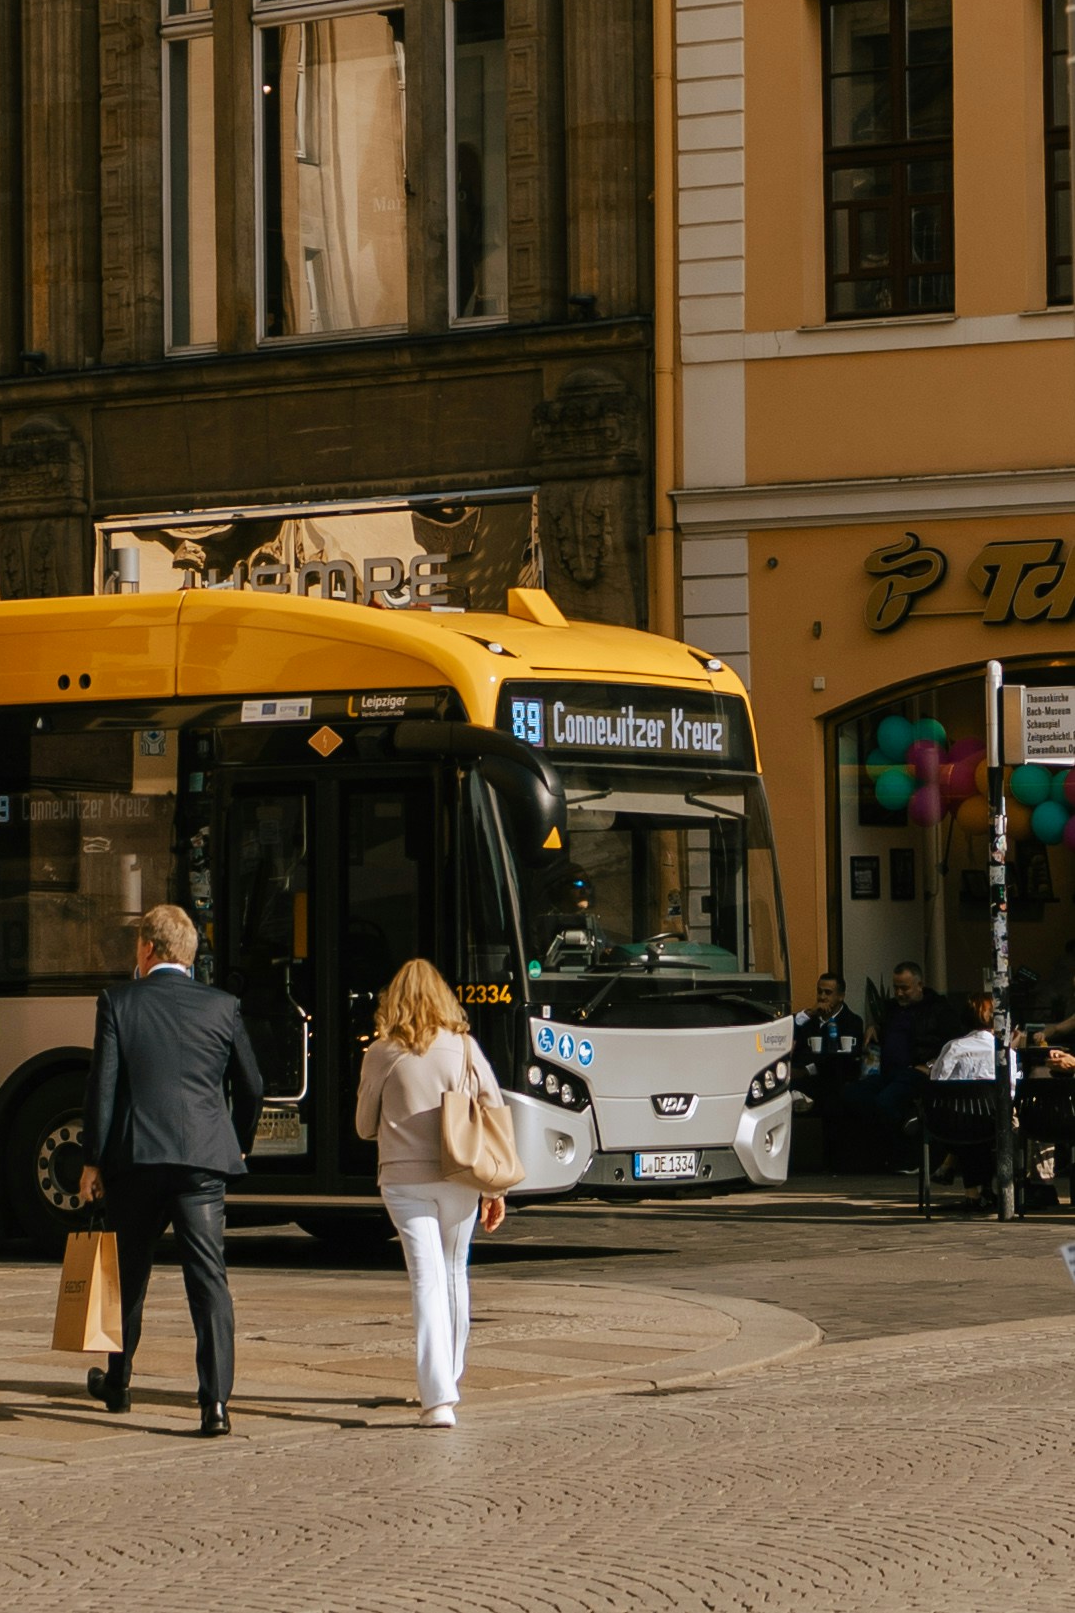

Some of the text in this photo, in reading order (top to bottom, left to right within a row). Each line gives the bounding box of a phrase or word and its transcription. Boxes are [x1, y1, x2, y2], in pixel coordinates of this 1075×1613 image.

[361, 694, 407, 709] Leipziger
[1027, 693, 1069, 703] Thomaskirche
[1027, 707, 1071, 717] Bach-Museum
[512, 701, 723, 751] 89 Connewitzer Kreuz
[1027, 719, 1060, 730] Schauspiel
[22, 791, 104, 821] Connewitzer
[110, 789, 150, 818] Kreuz
[456, 984, 512, 1004] 12334
[656, 1096, 687, 1112] VDL
